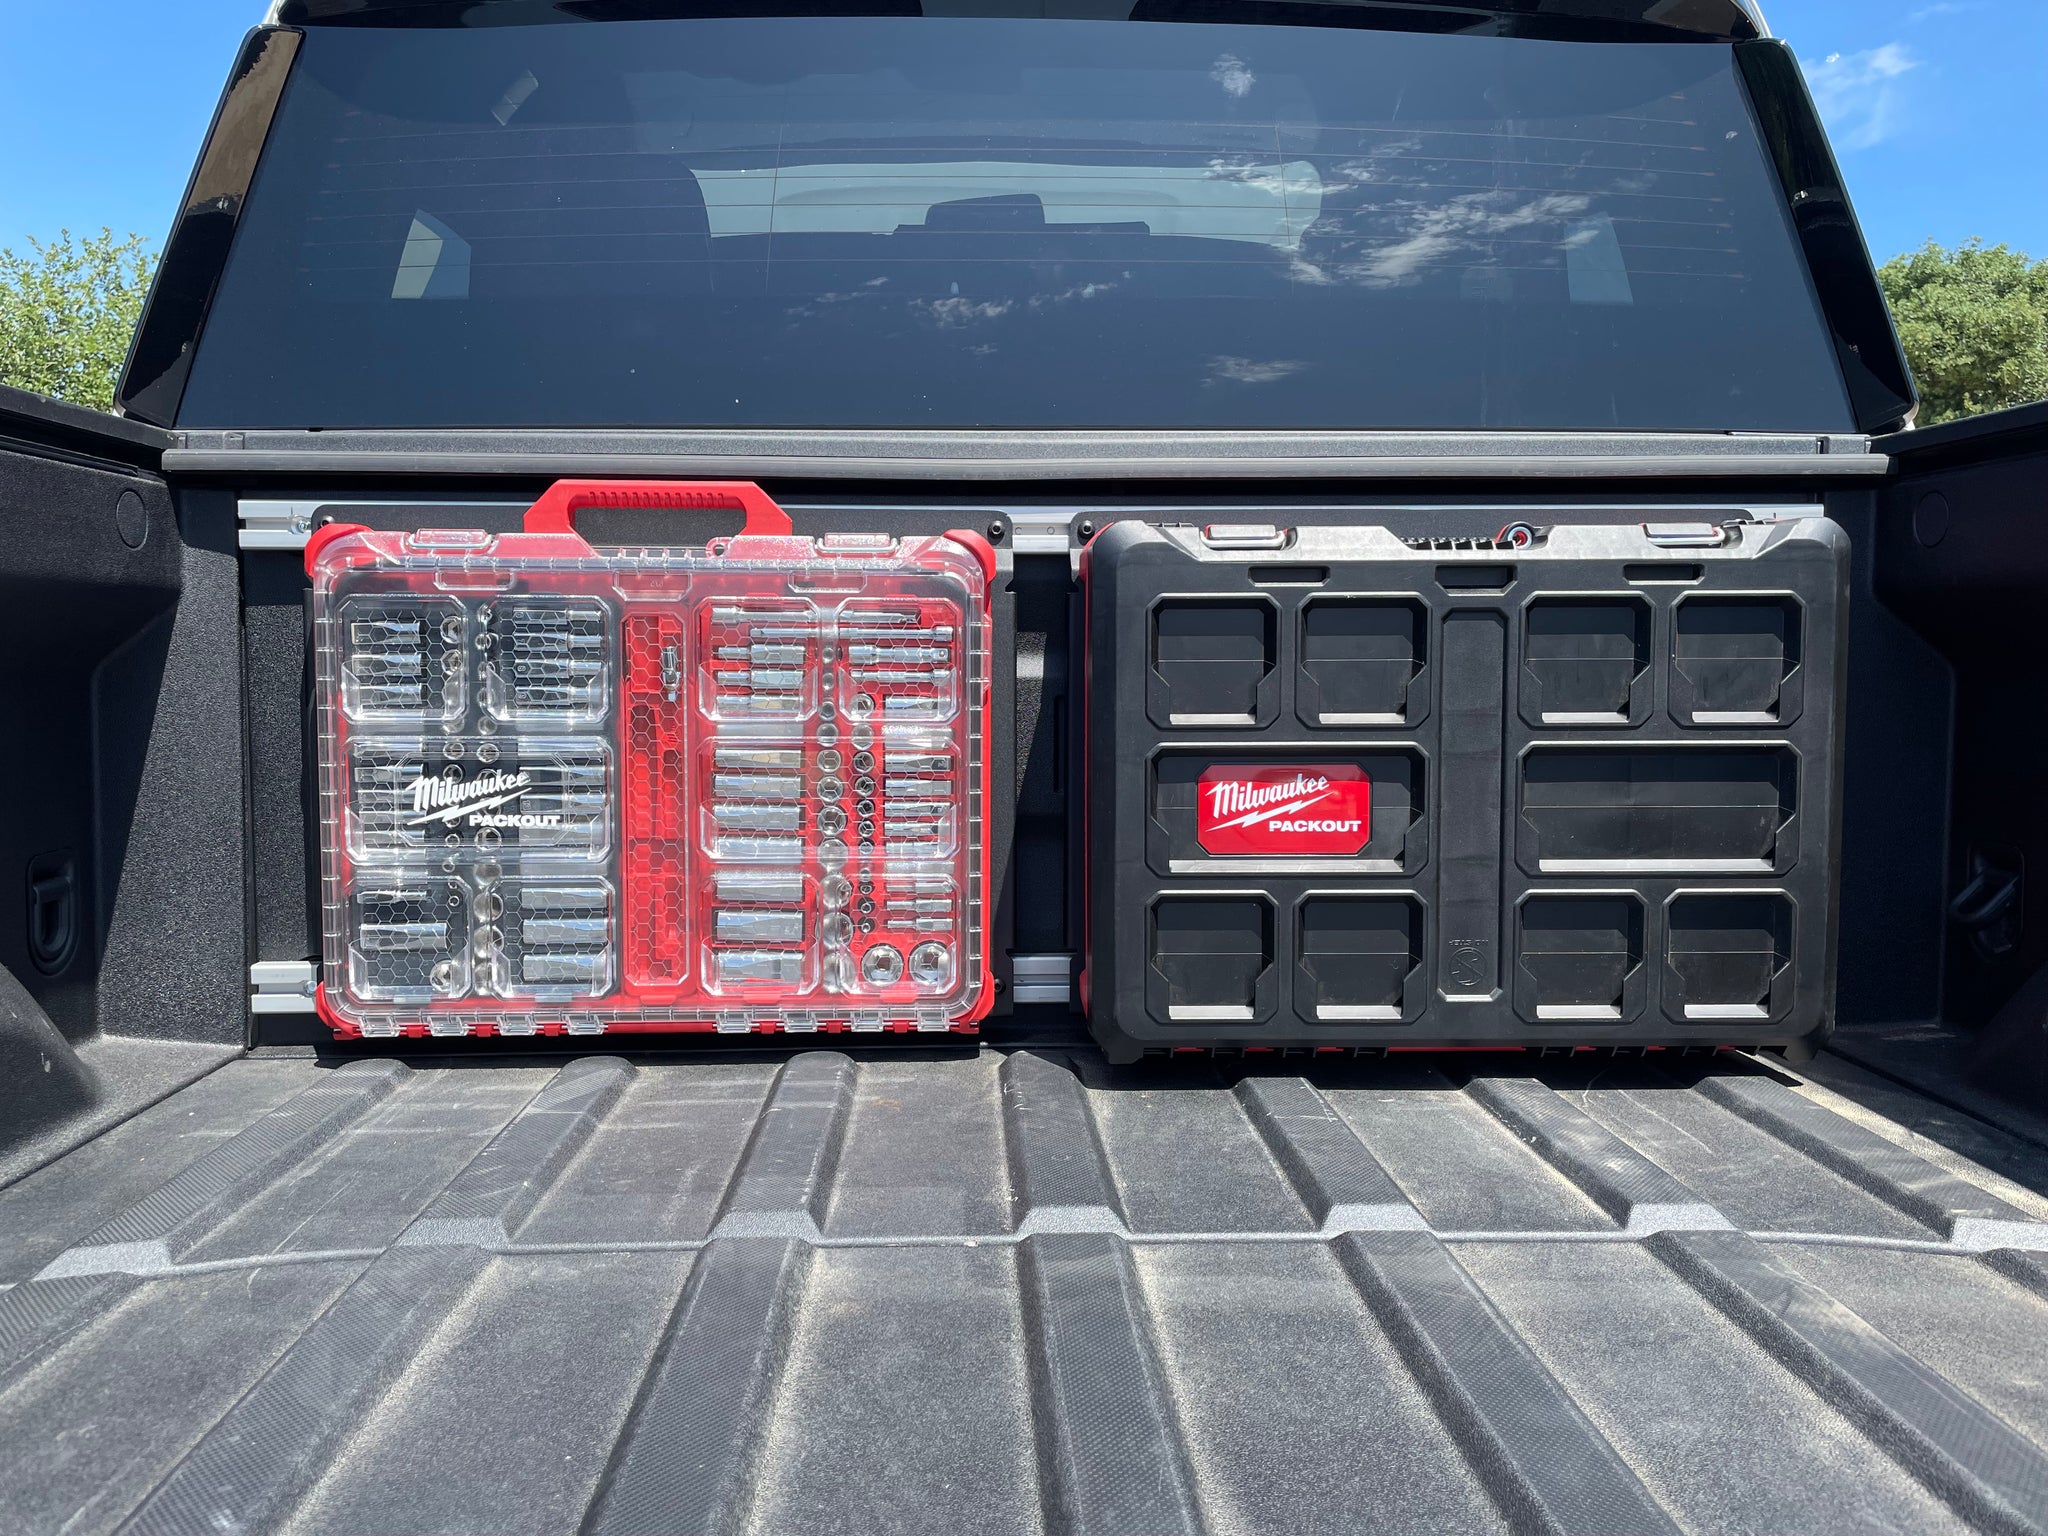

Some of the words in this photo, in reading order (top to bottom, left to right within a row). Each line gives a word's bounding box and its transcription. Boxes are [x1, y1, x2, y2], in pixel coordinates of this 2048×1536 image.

[404, 769, 531, 812] Milwaukee
[1205, 773, 1330, 818] Milwaukee
[469, 815, 561, 827] PACKOUT
[1268, 820, 1362, 832] PACKOUT
